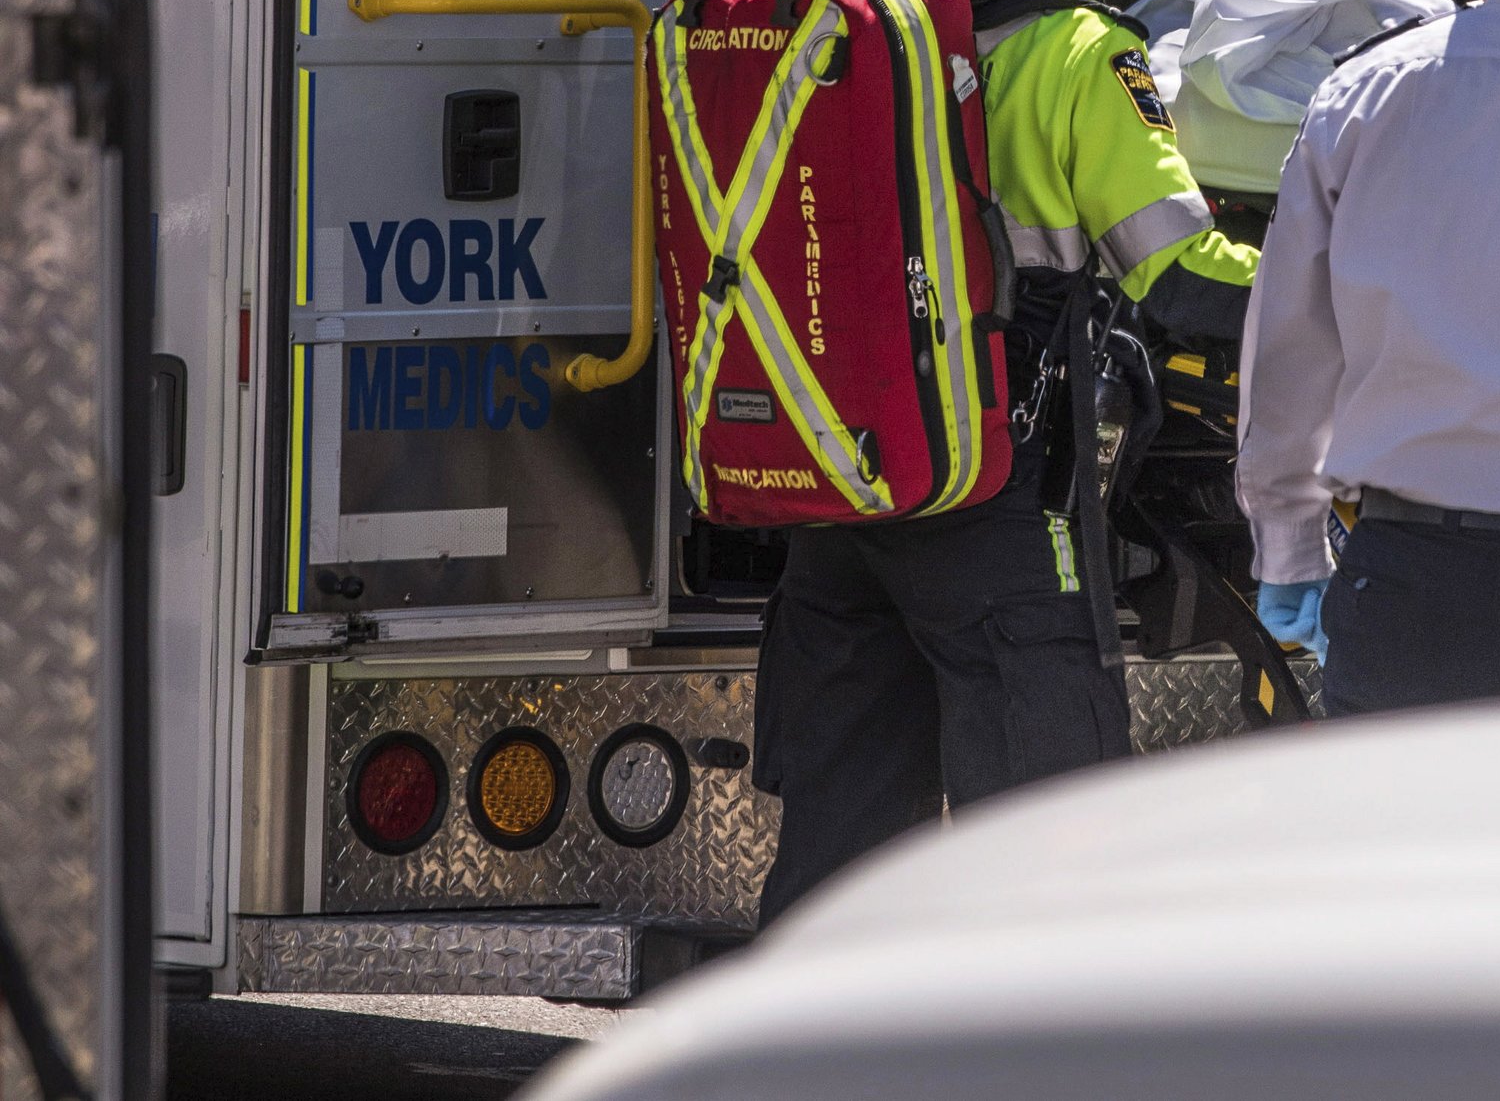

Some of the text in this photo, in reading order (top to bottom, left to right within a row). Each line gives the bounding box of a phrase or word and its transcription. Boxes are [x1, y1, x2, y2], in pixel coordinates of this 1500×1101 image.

[689, 28, 788, 51] CIRCATION
[659, 155, 671, 229] YORK
[349, 218, 548, 305] YORK
[348, 343, 550, 431] MEDICS
